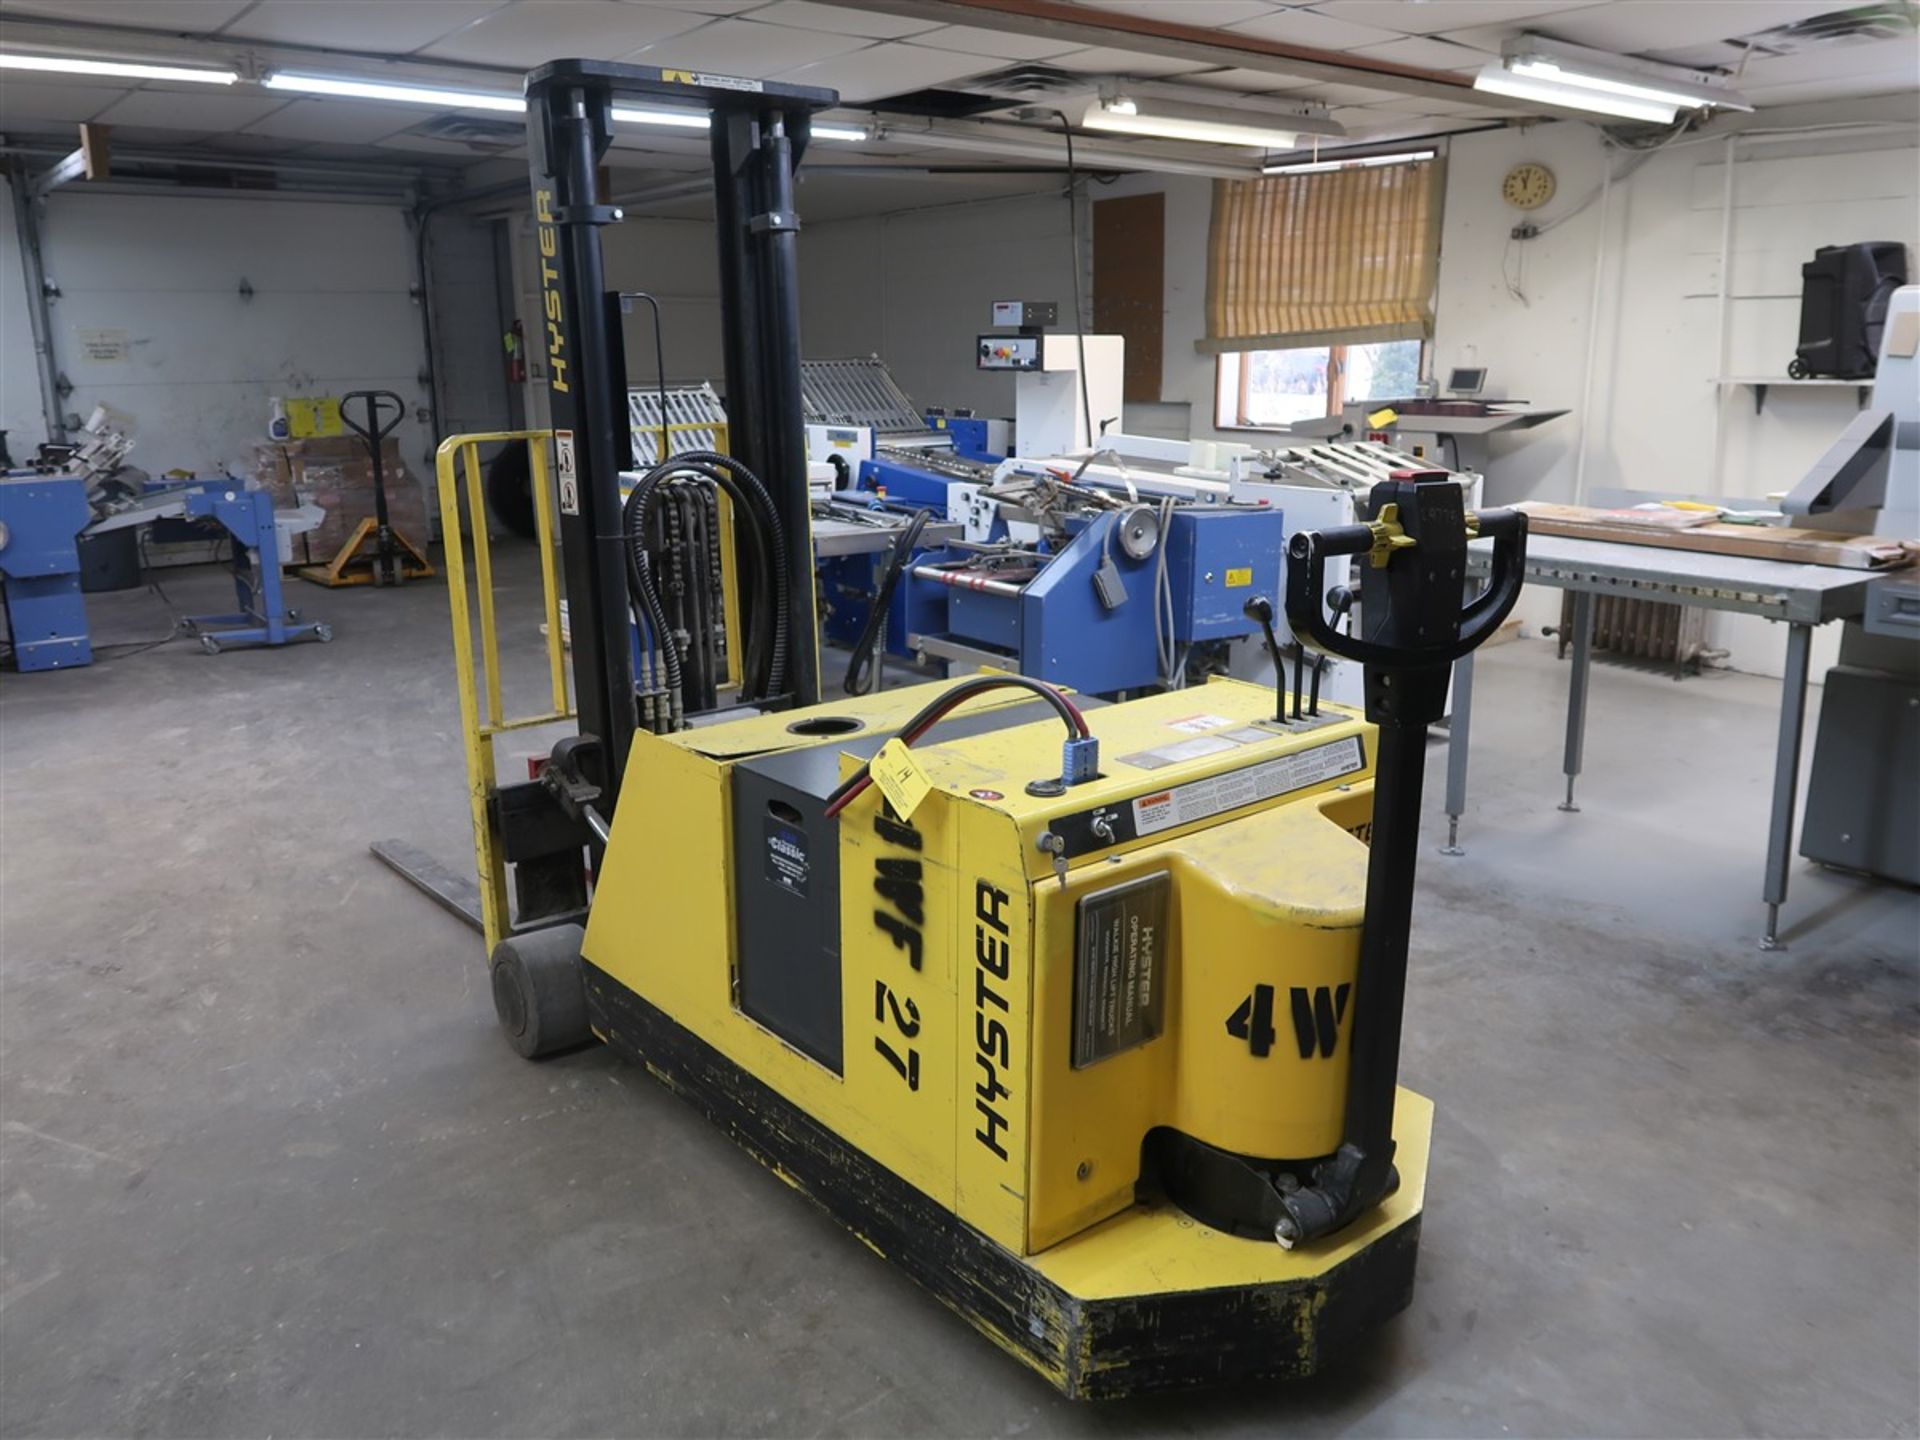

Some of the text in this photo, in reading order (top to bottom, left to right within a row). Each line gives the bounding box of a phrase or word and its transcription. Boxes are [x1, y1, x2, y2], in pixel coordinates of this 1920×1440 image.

[537, 190, 569, 393] HYSTER
[896, 766, 914, 784] 14
[769, 836, 806, 862] Classic
[1109, 979, 1118, 998] LIFT
[1124, 915, 1139, 1027] OPERATING MANUAL
[1139, 927, 1153, 1007] HYSTER
[875, 979, 921, 1092] 27
[976, 878, 1009, 1163] HYSTER
[1107, 1000, 1117, 1037] TRUCKS
